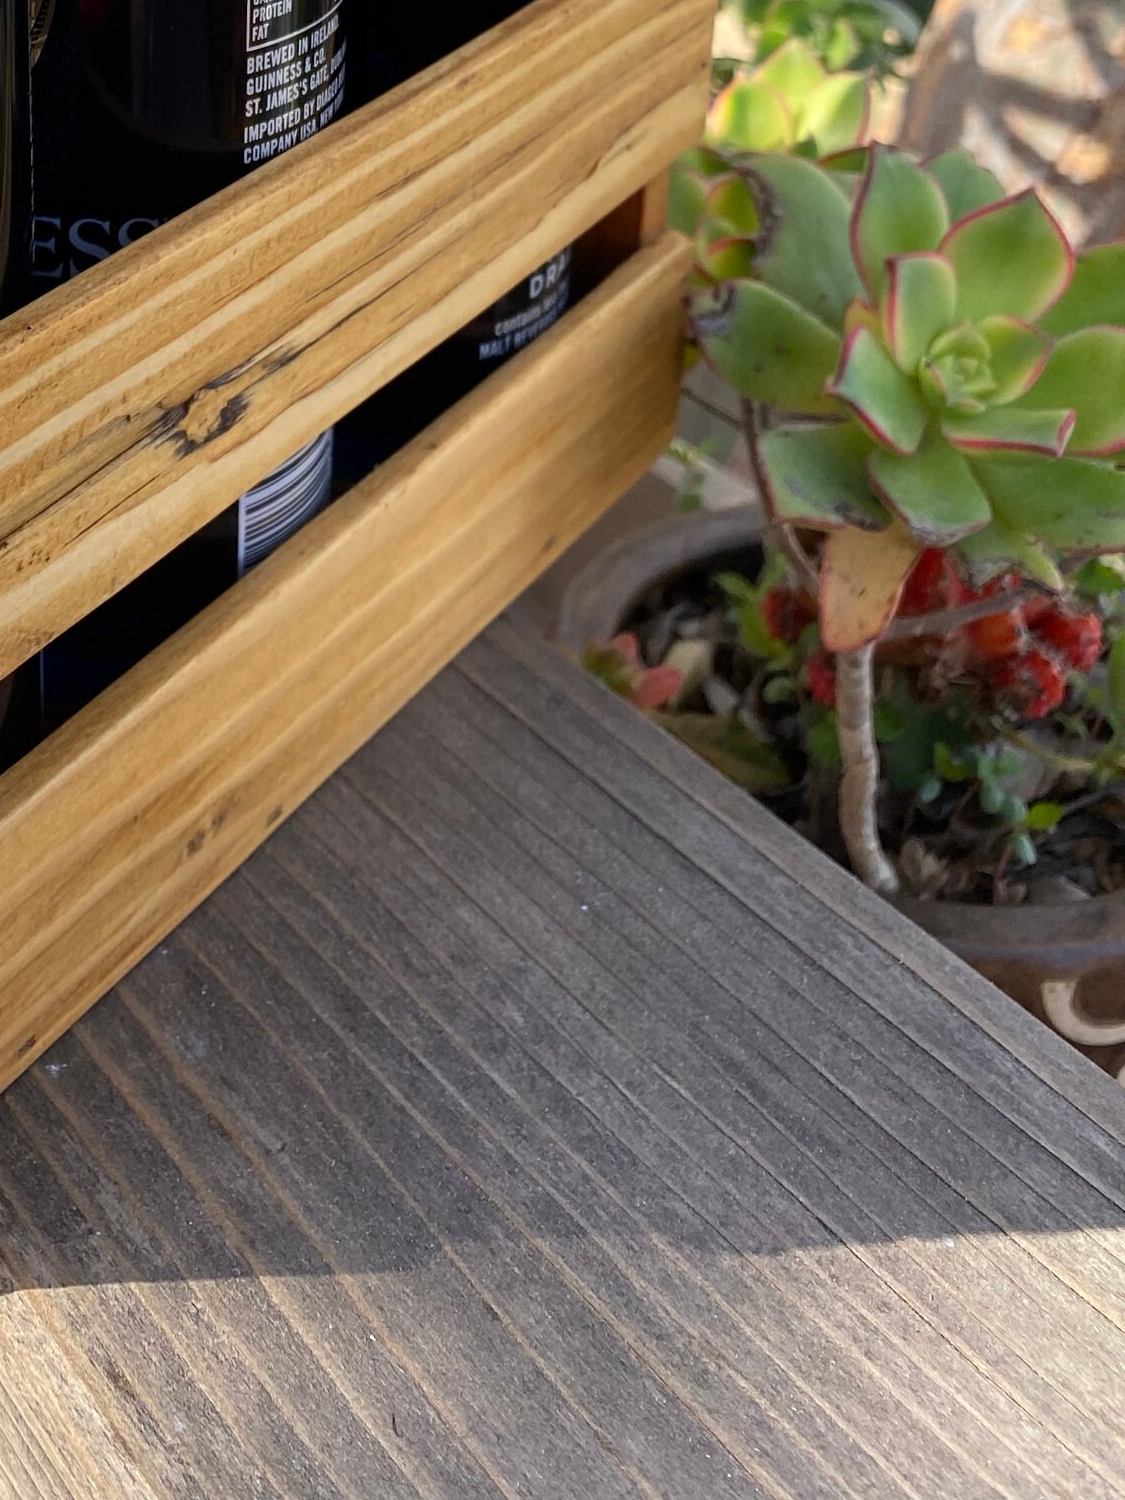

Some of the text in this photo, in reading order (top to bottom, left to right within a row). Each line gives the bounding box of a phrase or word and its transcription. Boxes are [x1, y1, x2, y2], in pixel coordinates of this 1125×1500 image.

[252, 23, 270, 42] FAT
[246, 43, 295, 75] BREWED
[298, 36, 309, 56] IN
[246, 61, 302, 96] GUINNESS
[304, 56, 312, 74] &
[245, 97, 263, 118] ST.
[265, 78, 308, 112] JAMES'S
[244, 107, 301, 144] IMPORTED
[303, 98, 315, 120] BY
[243, 128, 298, 164] COMPANY
